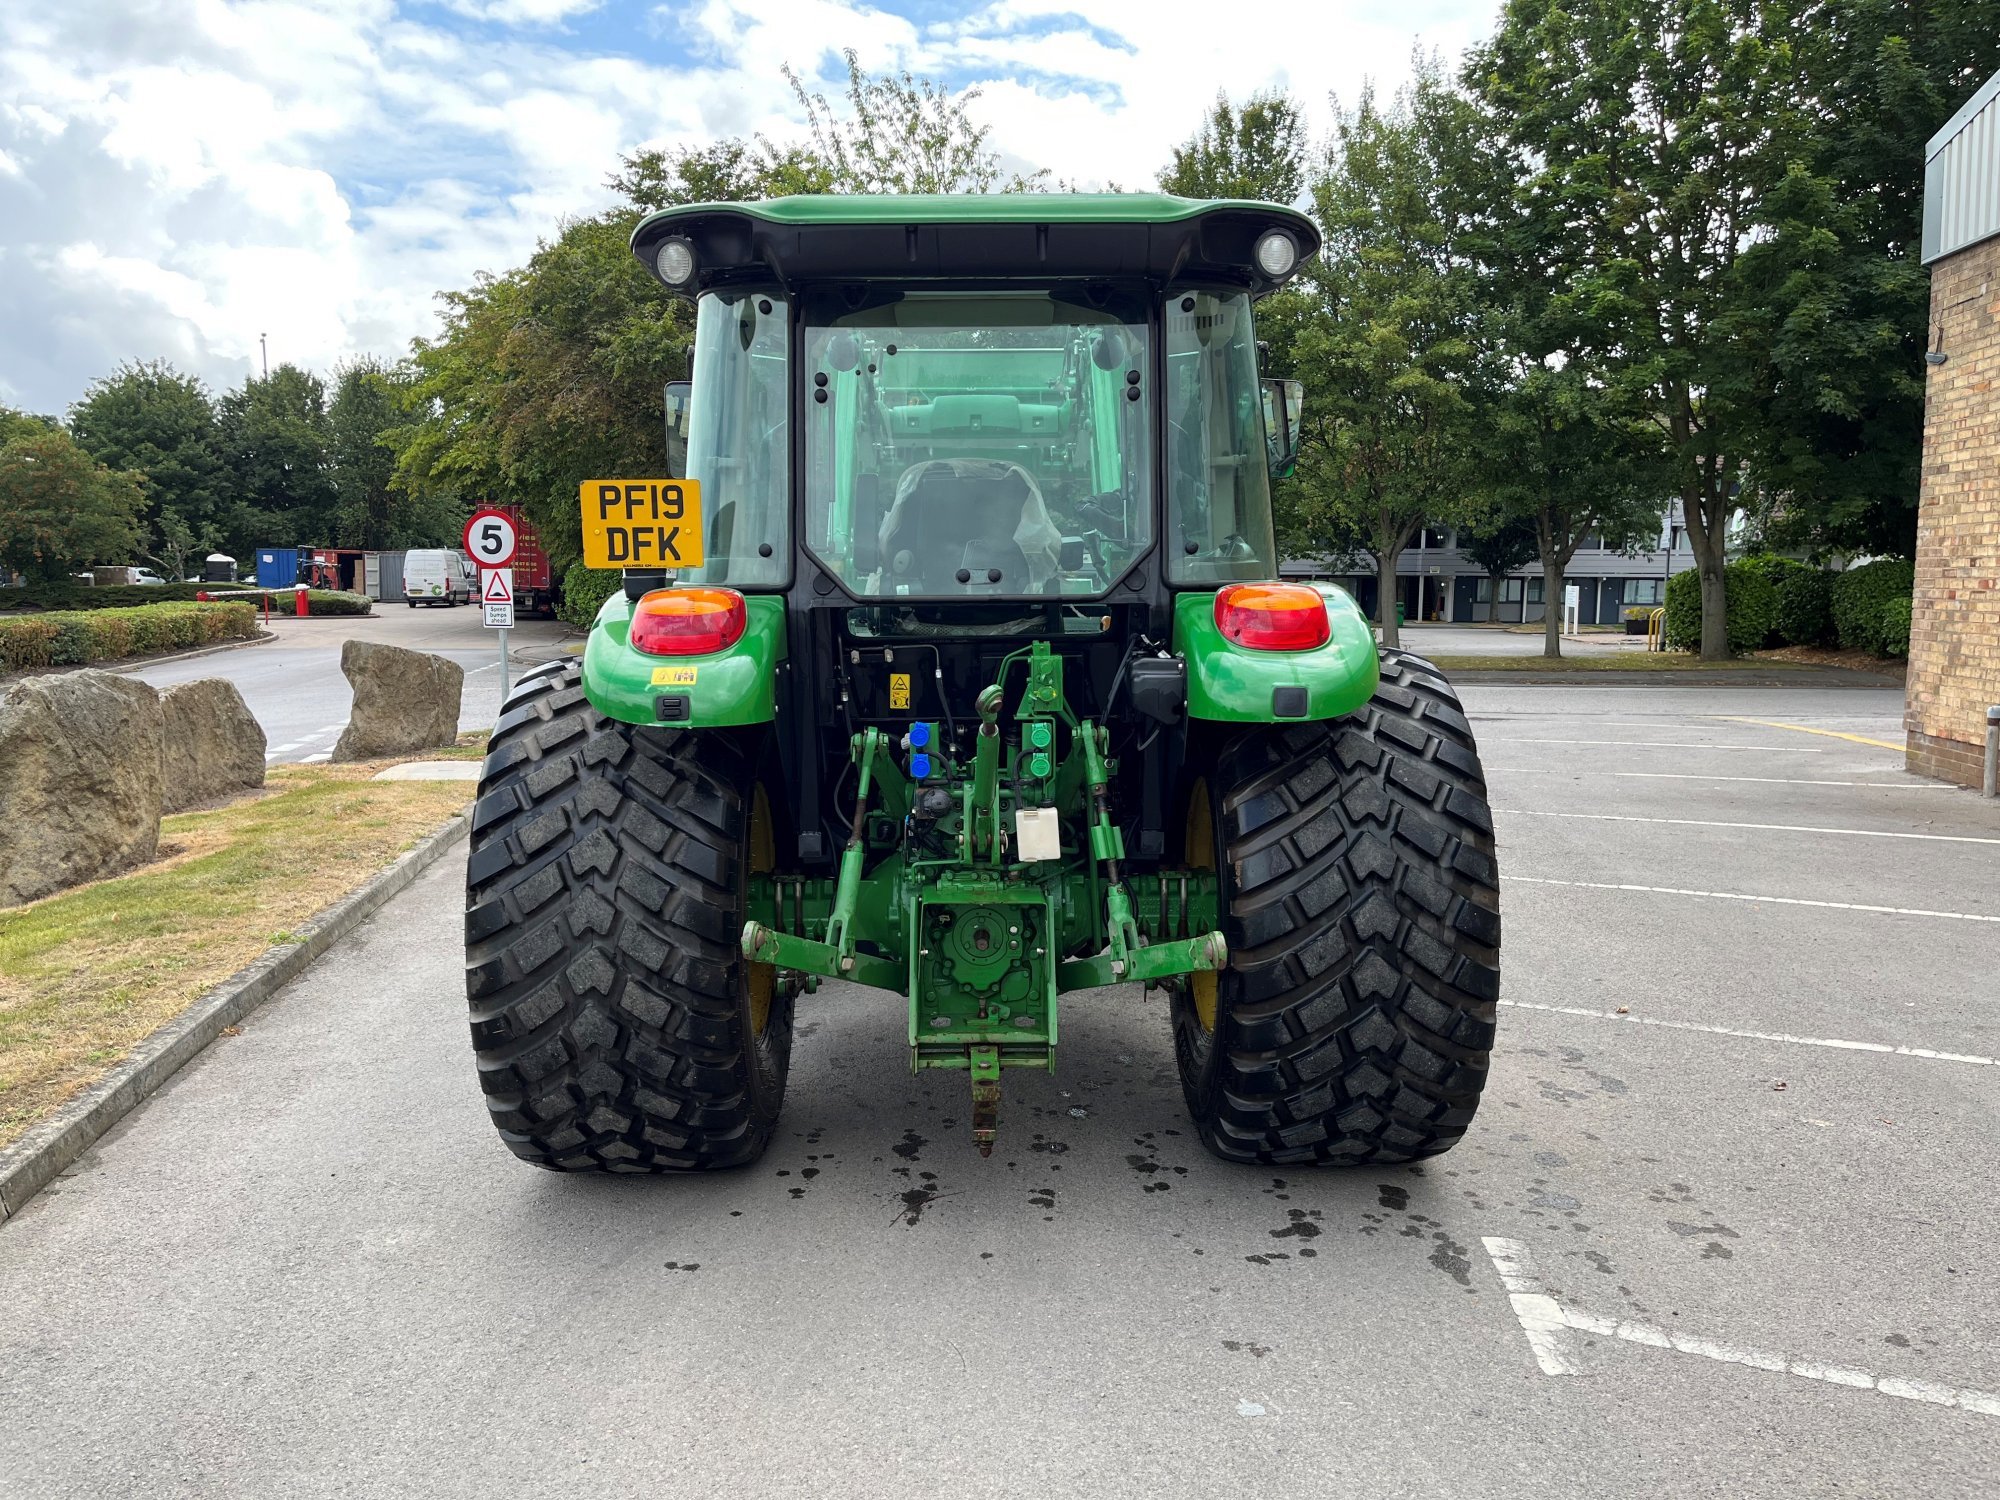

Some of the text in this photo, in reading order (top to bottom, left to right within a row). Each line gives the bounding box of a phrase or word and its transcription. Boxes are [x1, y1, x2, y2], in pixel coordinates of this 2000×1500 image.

[599, 485, 684, 520] PF19
[481, 524, 503, 555] 5
[606, 526, 681, 562] DFK
